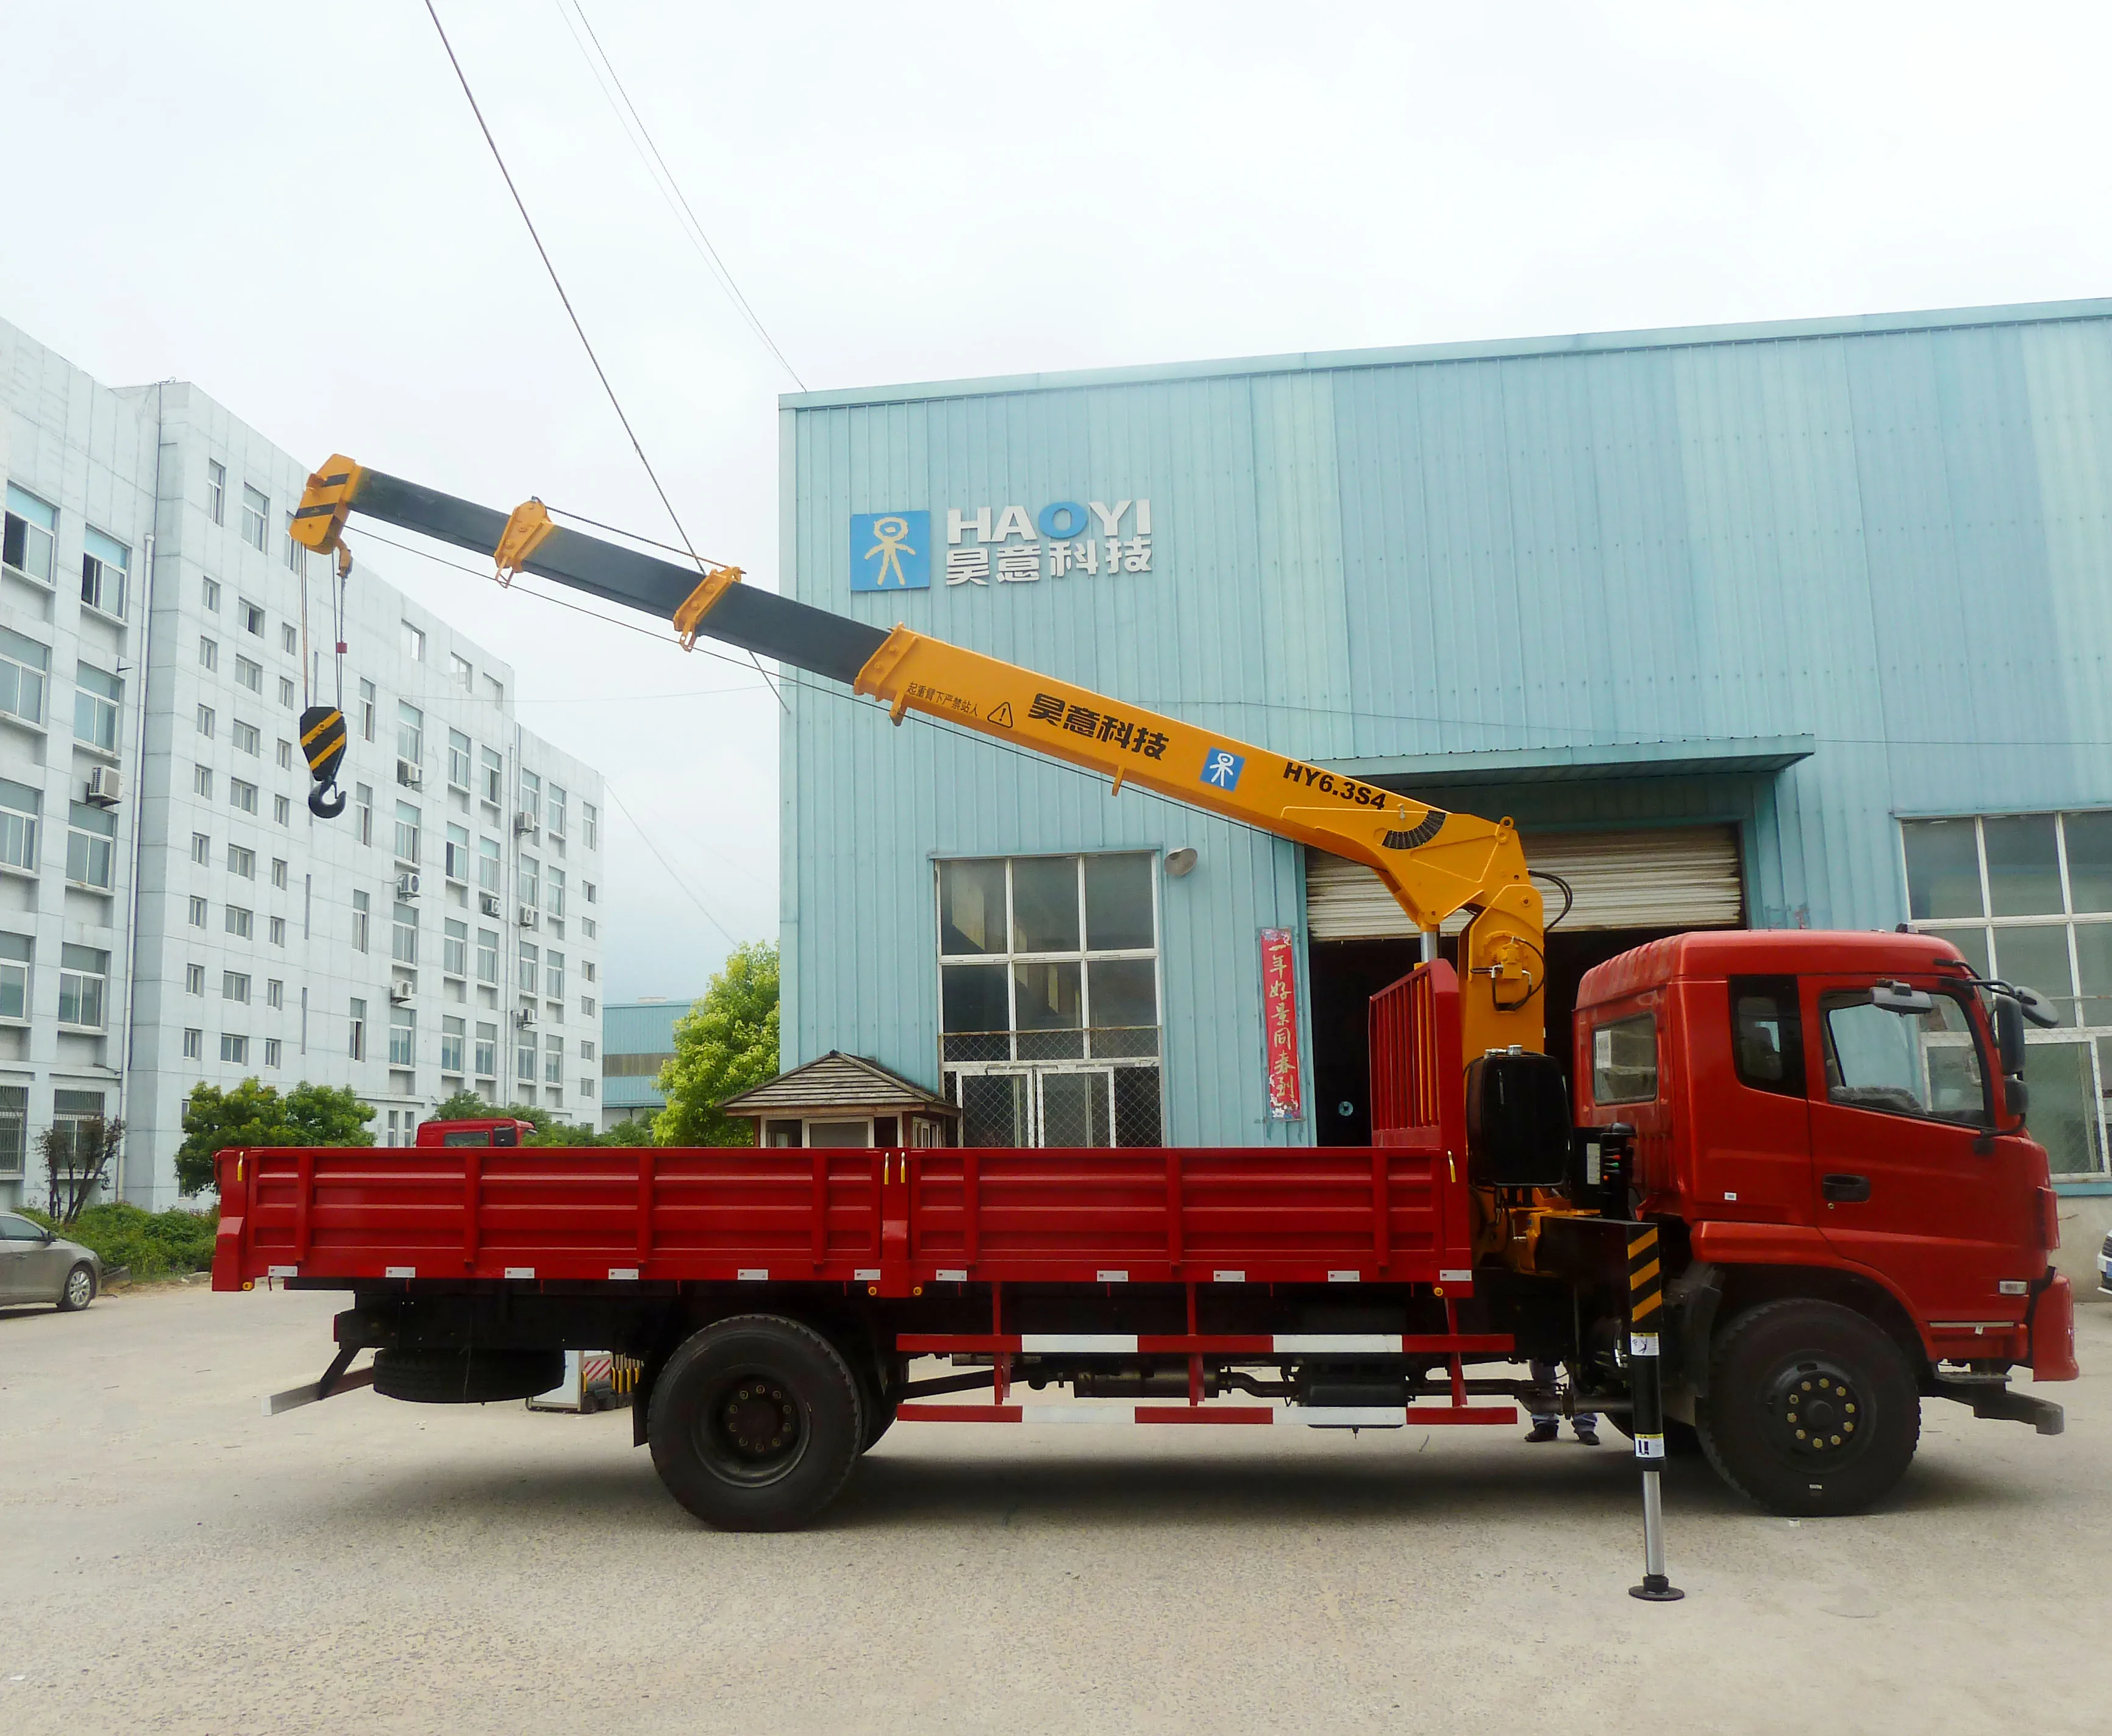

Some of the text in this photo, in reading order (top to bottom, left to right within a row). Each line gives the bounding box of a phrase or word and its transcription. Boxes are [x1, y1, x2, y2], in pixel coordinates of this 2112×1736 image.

[947, 499, 1151, 544] HAOYI
[946, 536, 1152, 585] 昊意科技
[906, 681, 979, 716] 起重臂下严禁站人
[1028, 693, 1169, 760] 昊意科技
[1283, 762, 1386, 810] HY6.3S4
